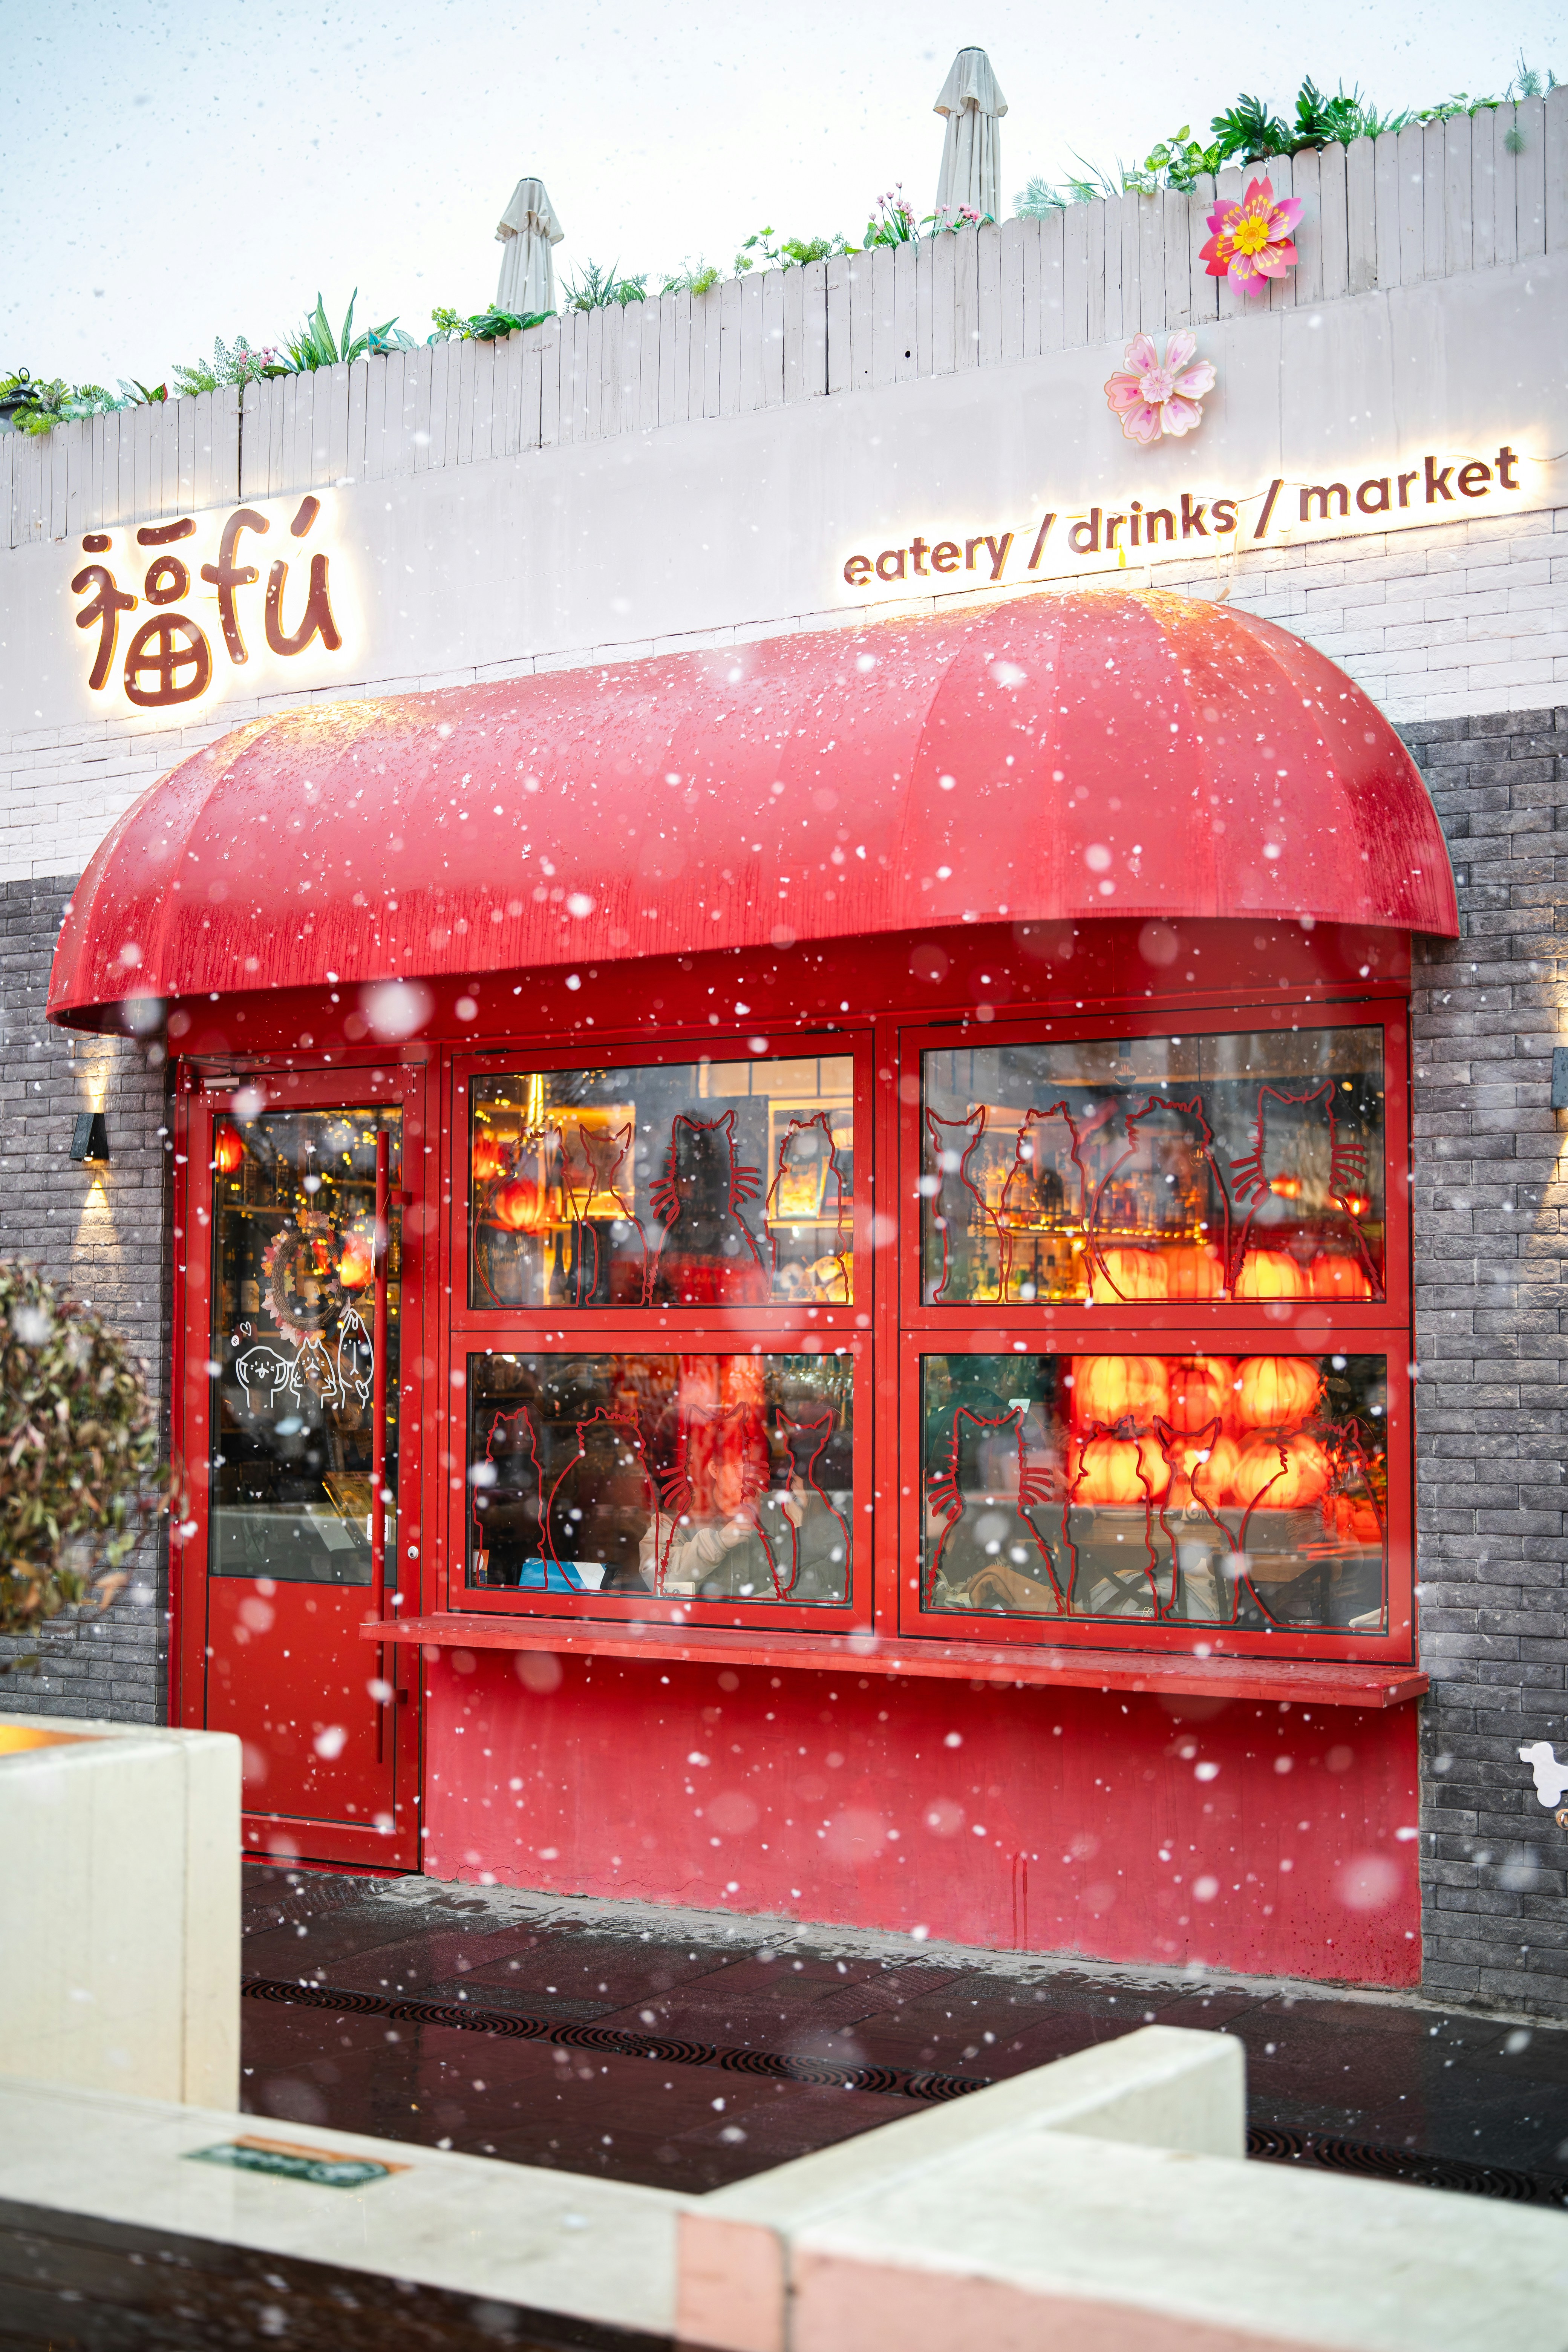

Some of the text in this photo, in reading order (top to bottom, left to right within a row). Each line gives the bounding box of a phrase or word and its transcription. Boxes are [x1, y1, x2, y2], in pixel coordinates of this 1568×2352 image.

[71, 496, 342, 707] 福 fú
[844, 446, 1520, 586] eatery / drinks / market
